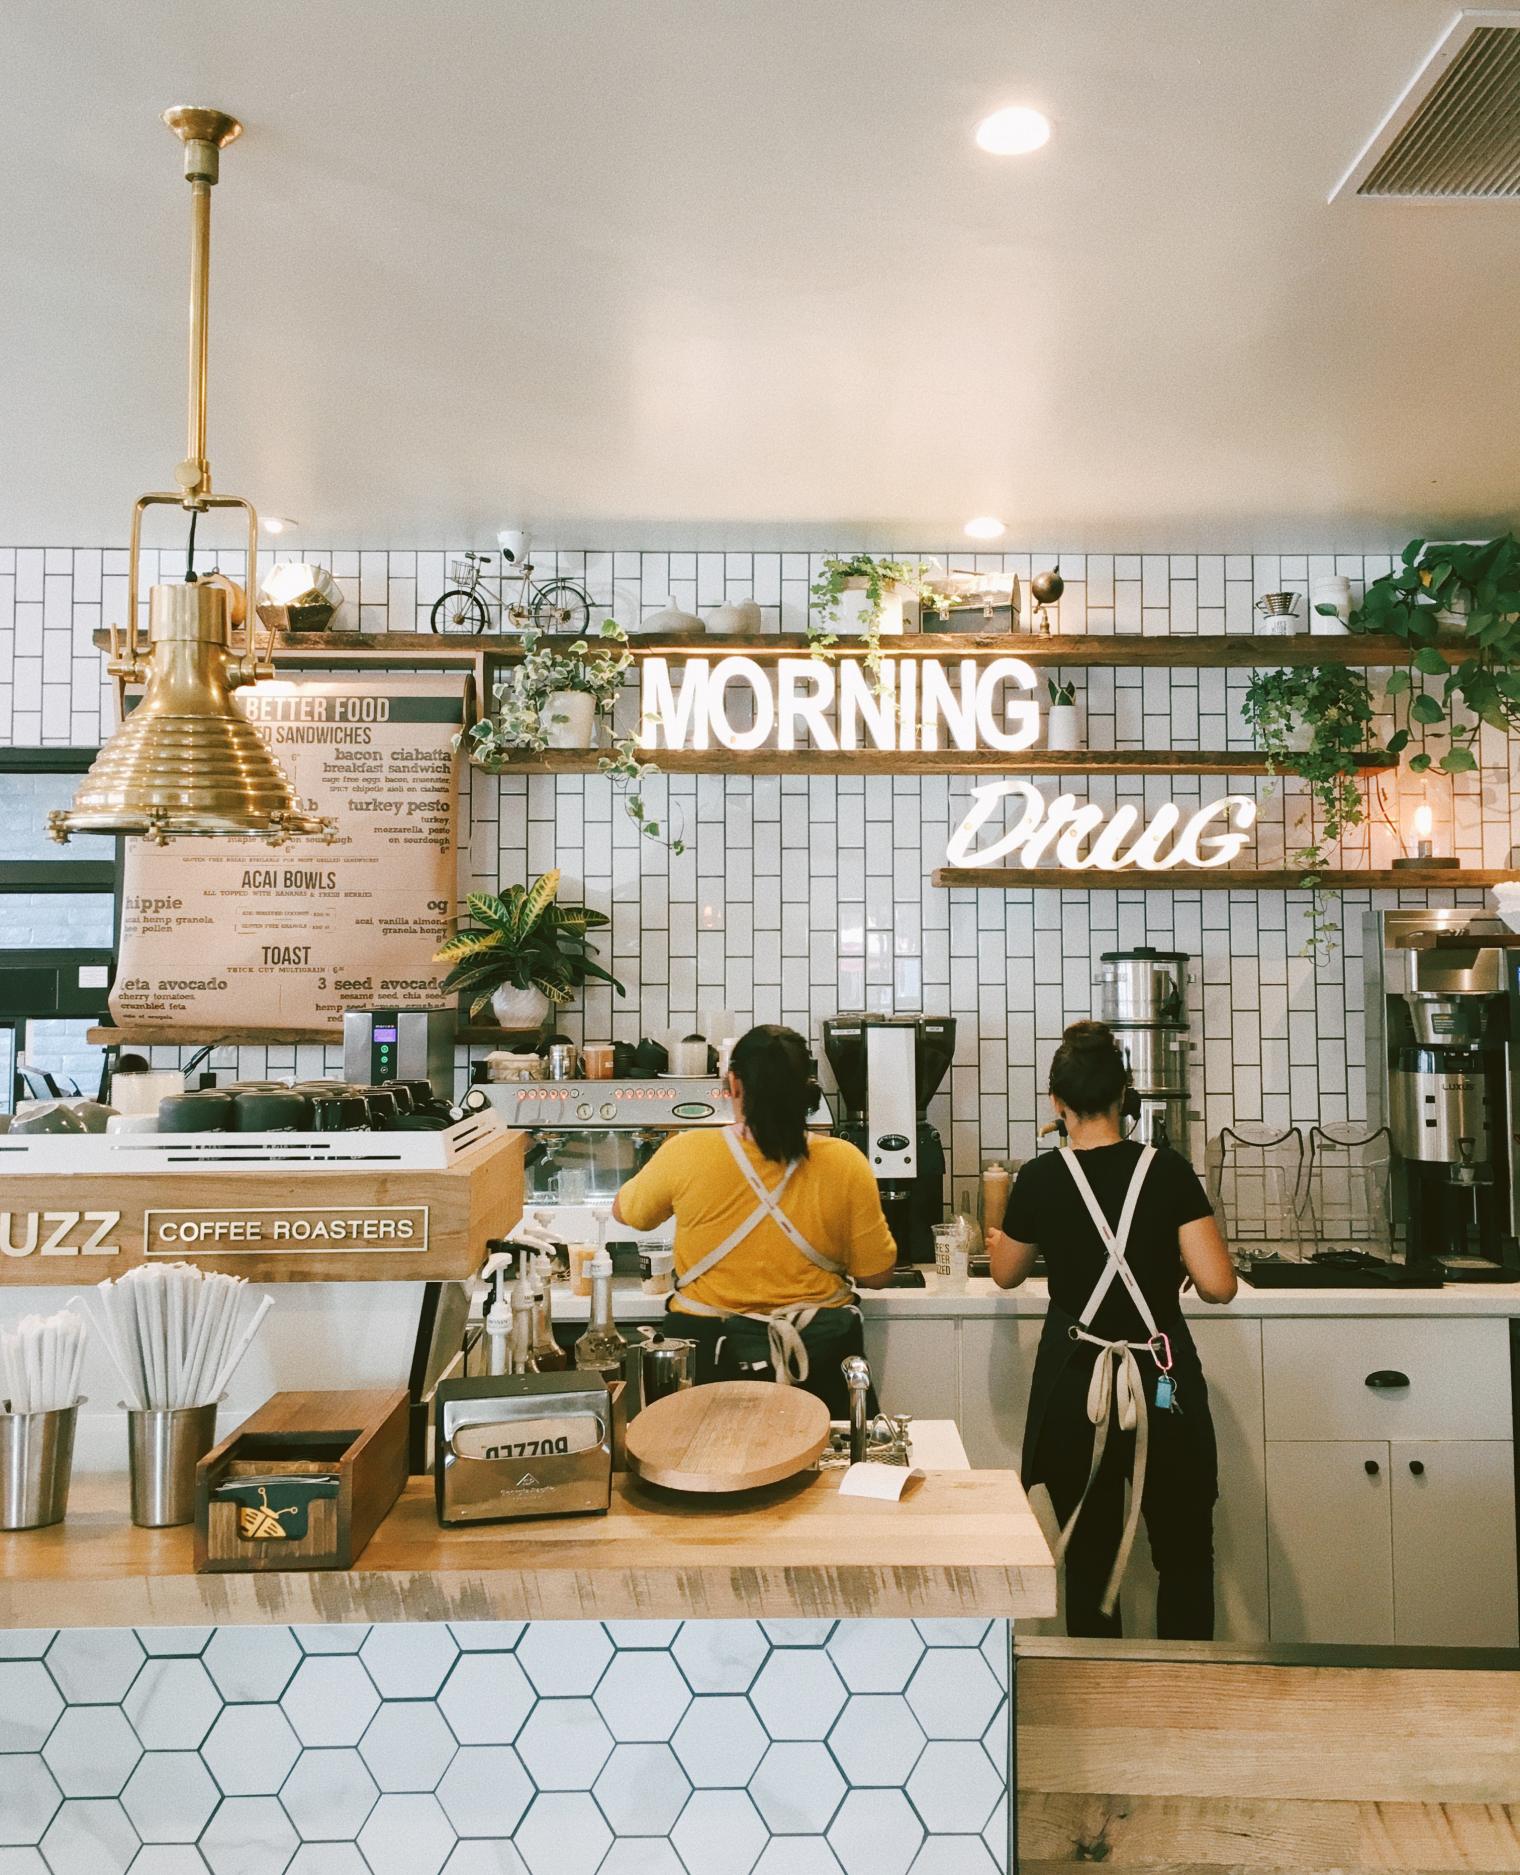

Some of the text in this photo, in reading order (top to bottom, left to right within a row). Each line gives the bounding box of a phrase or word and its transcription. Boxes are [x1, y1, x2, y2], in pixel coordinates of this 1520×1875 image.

[246, 696, 390, 722] BETTER FOOD
[641, 656, 1040, 751] MORNING
[276, 726, 372, 745] SANDWICHES
[334, 747, 452, 762] bacon ciabatta
[322, 762, 451, 774] breakfast sandwich
[342, 775, 359, 783] free
[348, 798, 450, 816] turkey pesto
[388, 836, 450, 846] on sourdough
[241, 869, 337, 890] ACAI BOWLS
[125, 895, 183, 914] hippie
[426, 900, 448, 915] og
[143, 915, 172, 925] hemp
[378, 917, 410, 925] vanilla
[142, 925, 173, 934] pollen
[419, 926, 448, 937] honey
[261, 946, 312, 965] TOAST
[158, 977, 228, 991] avocado
[317, 977, 328, 991] 3
[334, 977, 373, 990] seed
[118, 992, 150, 1001] cherry
[402, 992, 421, 1000] chia
[120, 1002, 187, 1011] crumbled feta
[315, 1003, 343, 1013] hemp
[159, 1221, 262, 1243] COFFEE
[273, 1219, 414, 1240] ROASTERS
